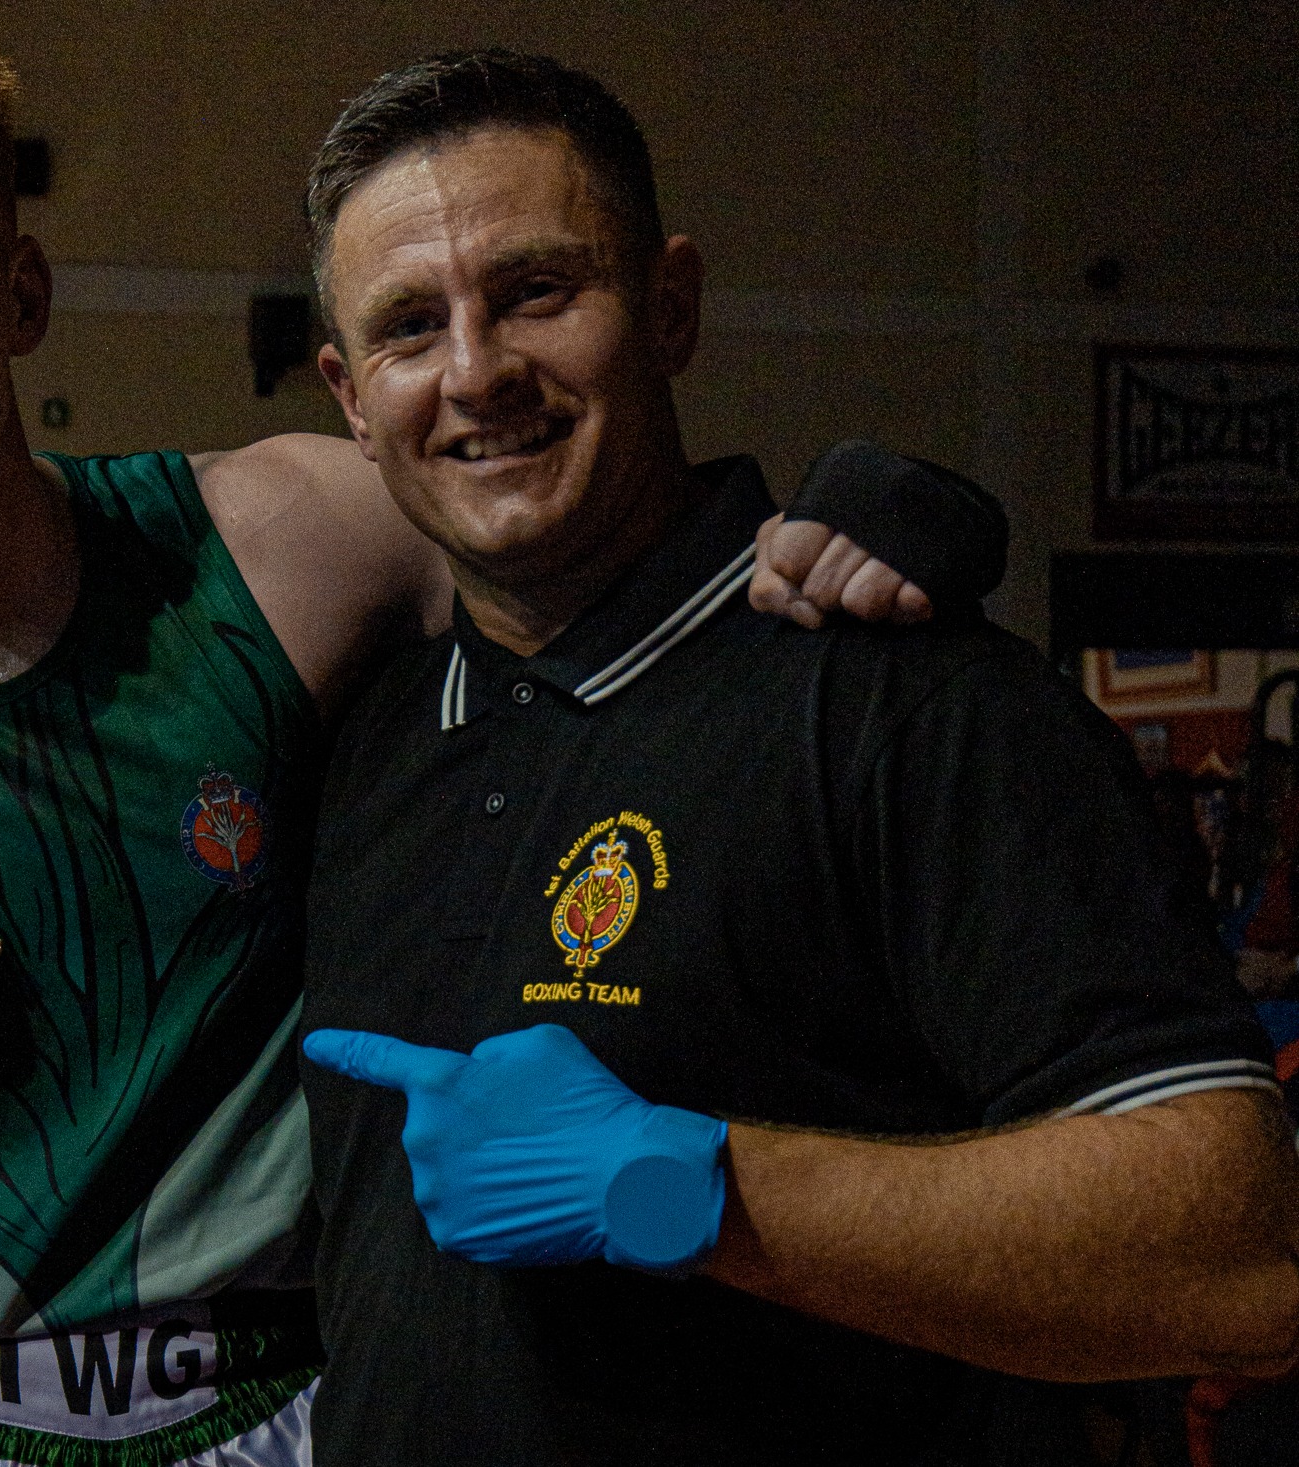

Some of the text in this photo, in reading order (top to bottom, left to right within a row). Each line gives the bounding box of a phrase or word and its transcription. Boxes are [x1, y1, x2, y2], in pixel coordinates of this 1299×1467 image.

[543, 810, 670, 897] 1st Battalion Welsh Guards
[522, 982, 642, 1006] BOXING TEAM
